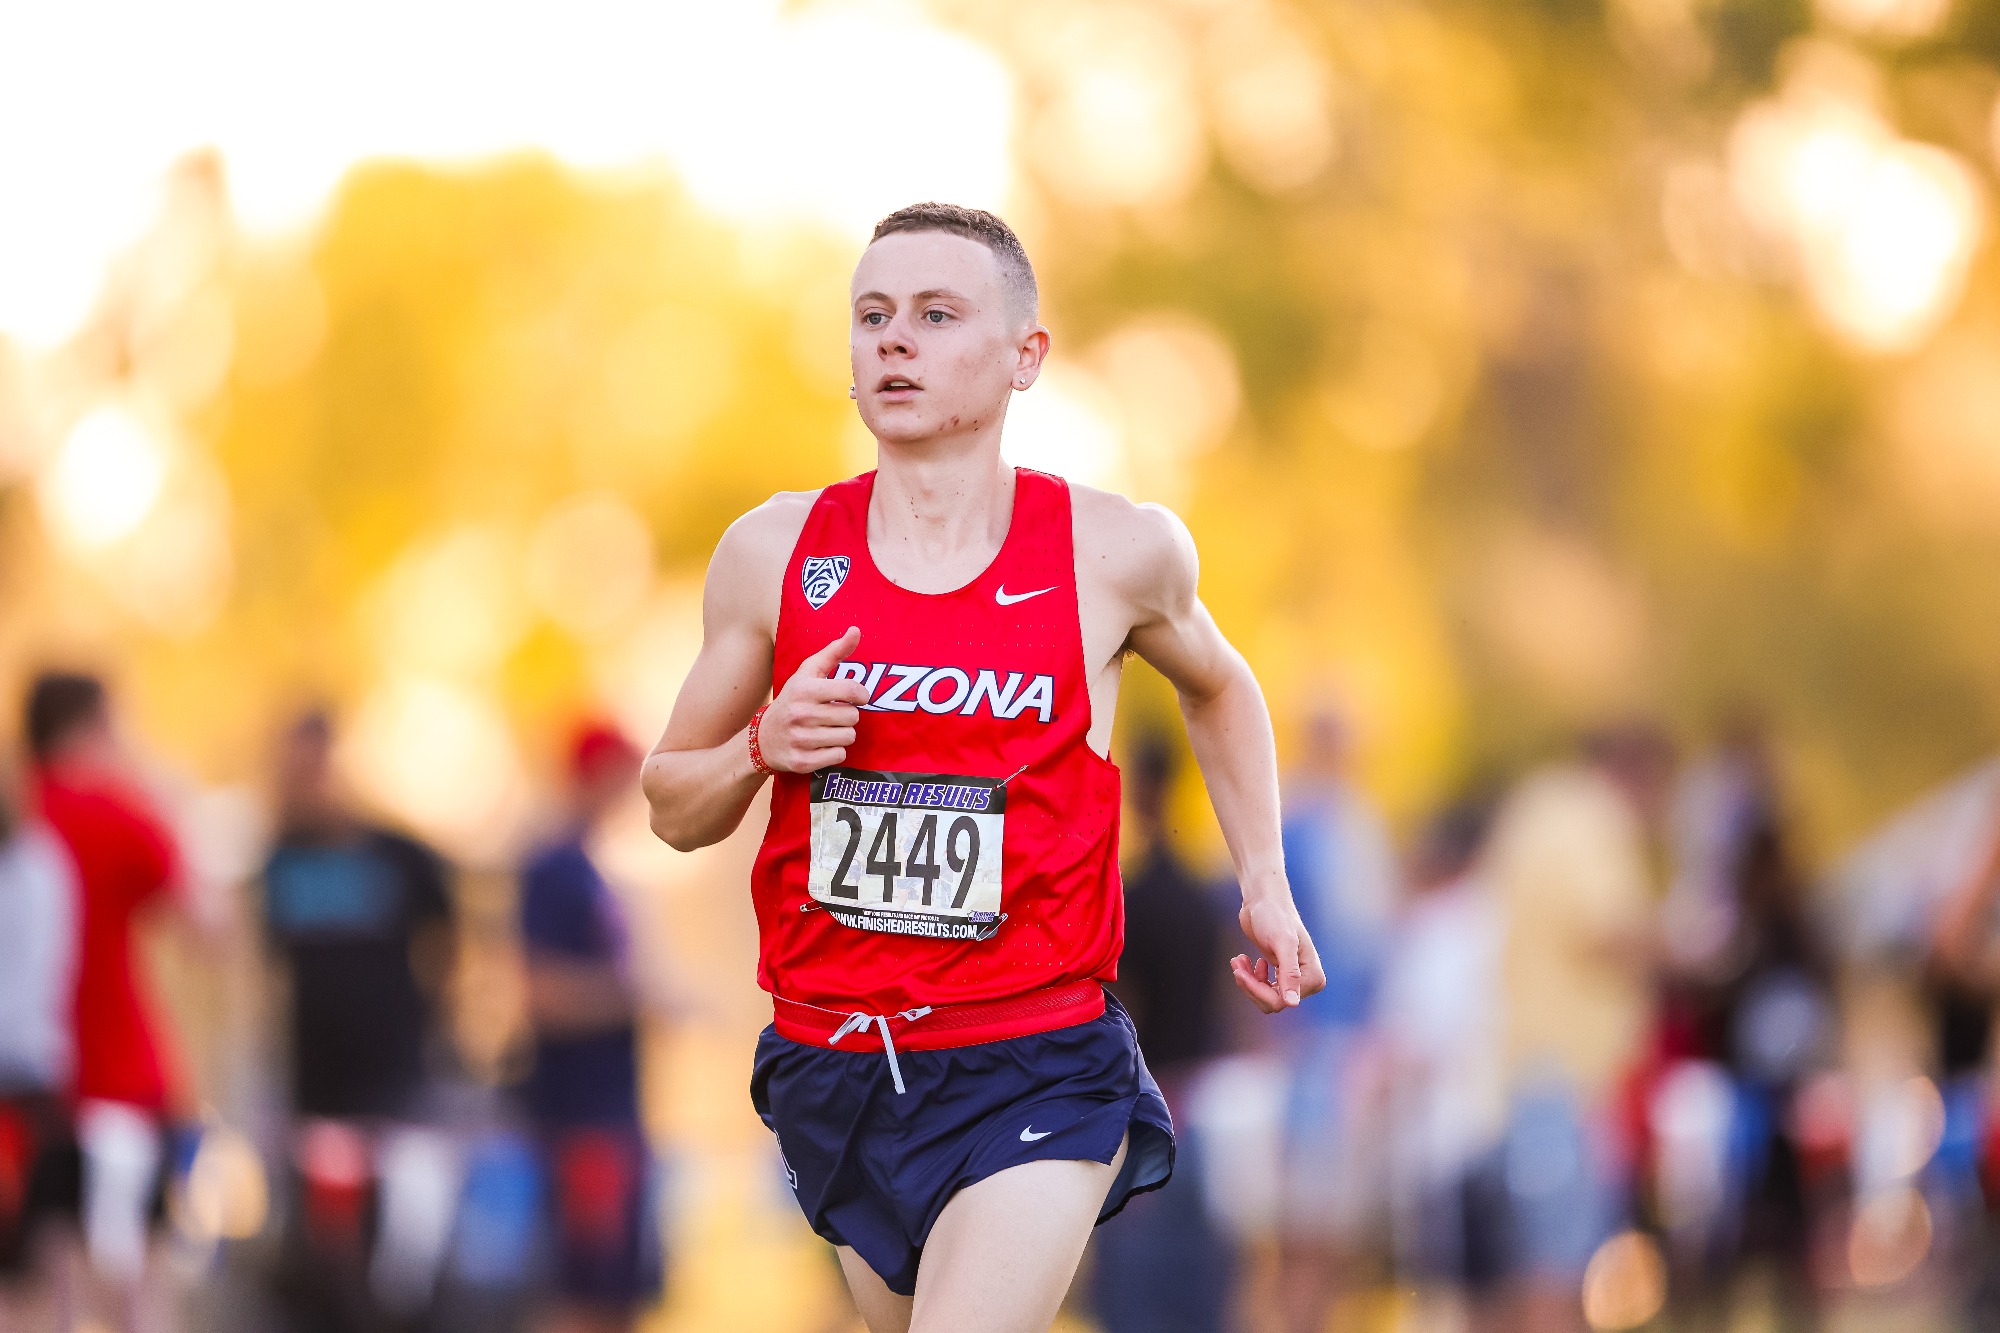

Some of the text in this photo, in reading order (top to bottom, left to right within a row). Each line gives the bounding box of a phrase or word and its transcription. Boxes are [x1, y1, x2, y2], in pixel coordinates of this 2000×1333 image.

[804, 557, 849, 587] PAC
[810, 583, 830, 598] 12
[826, 660, 1055, 724] RIZONA
[823, 773, 992, 811] FINISHED RESULTS
[831, 807, 980, 909] 2449
